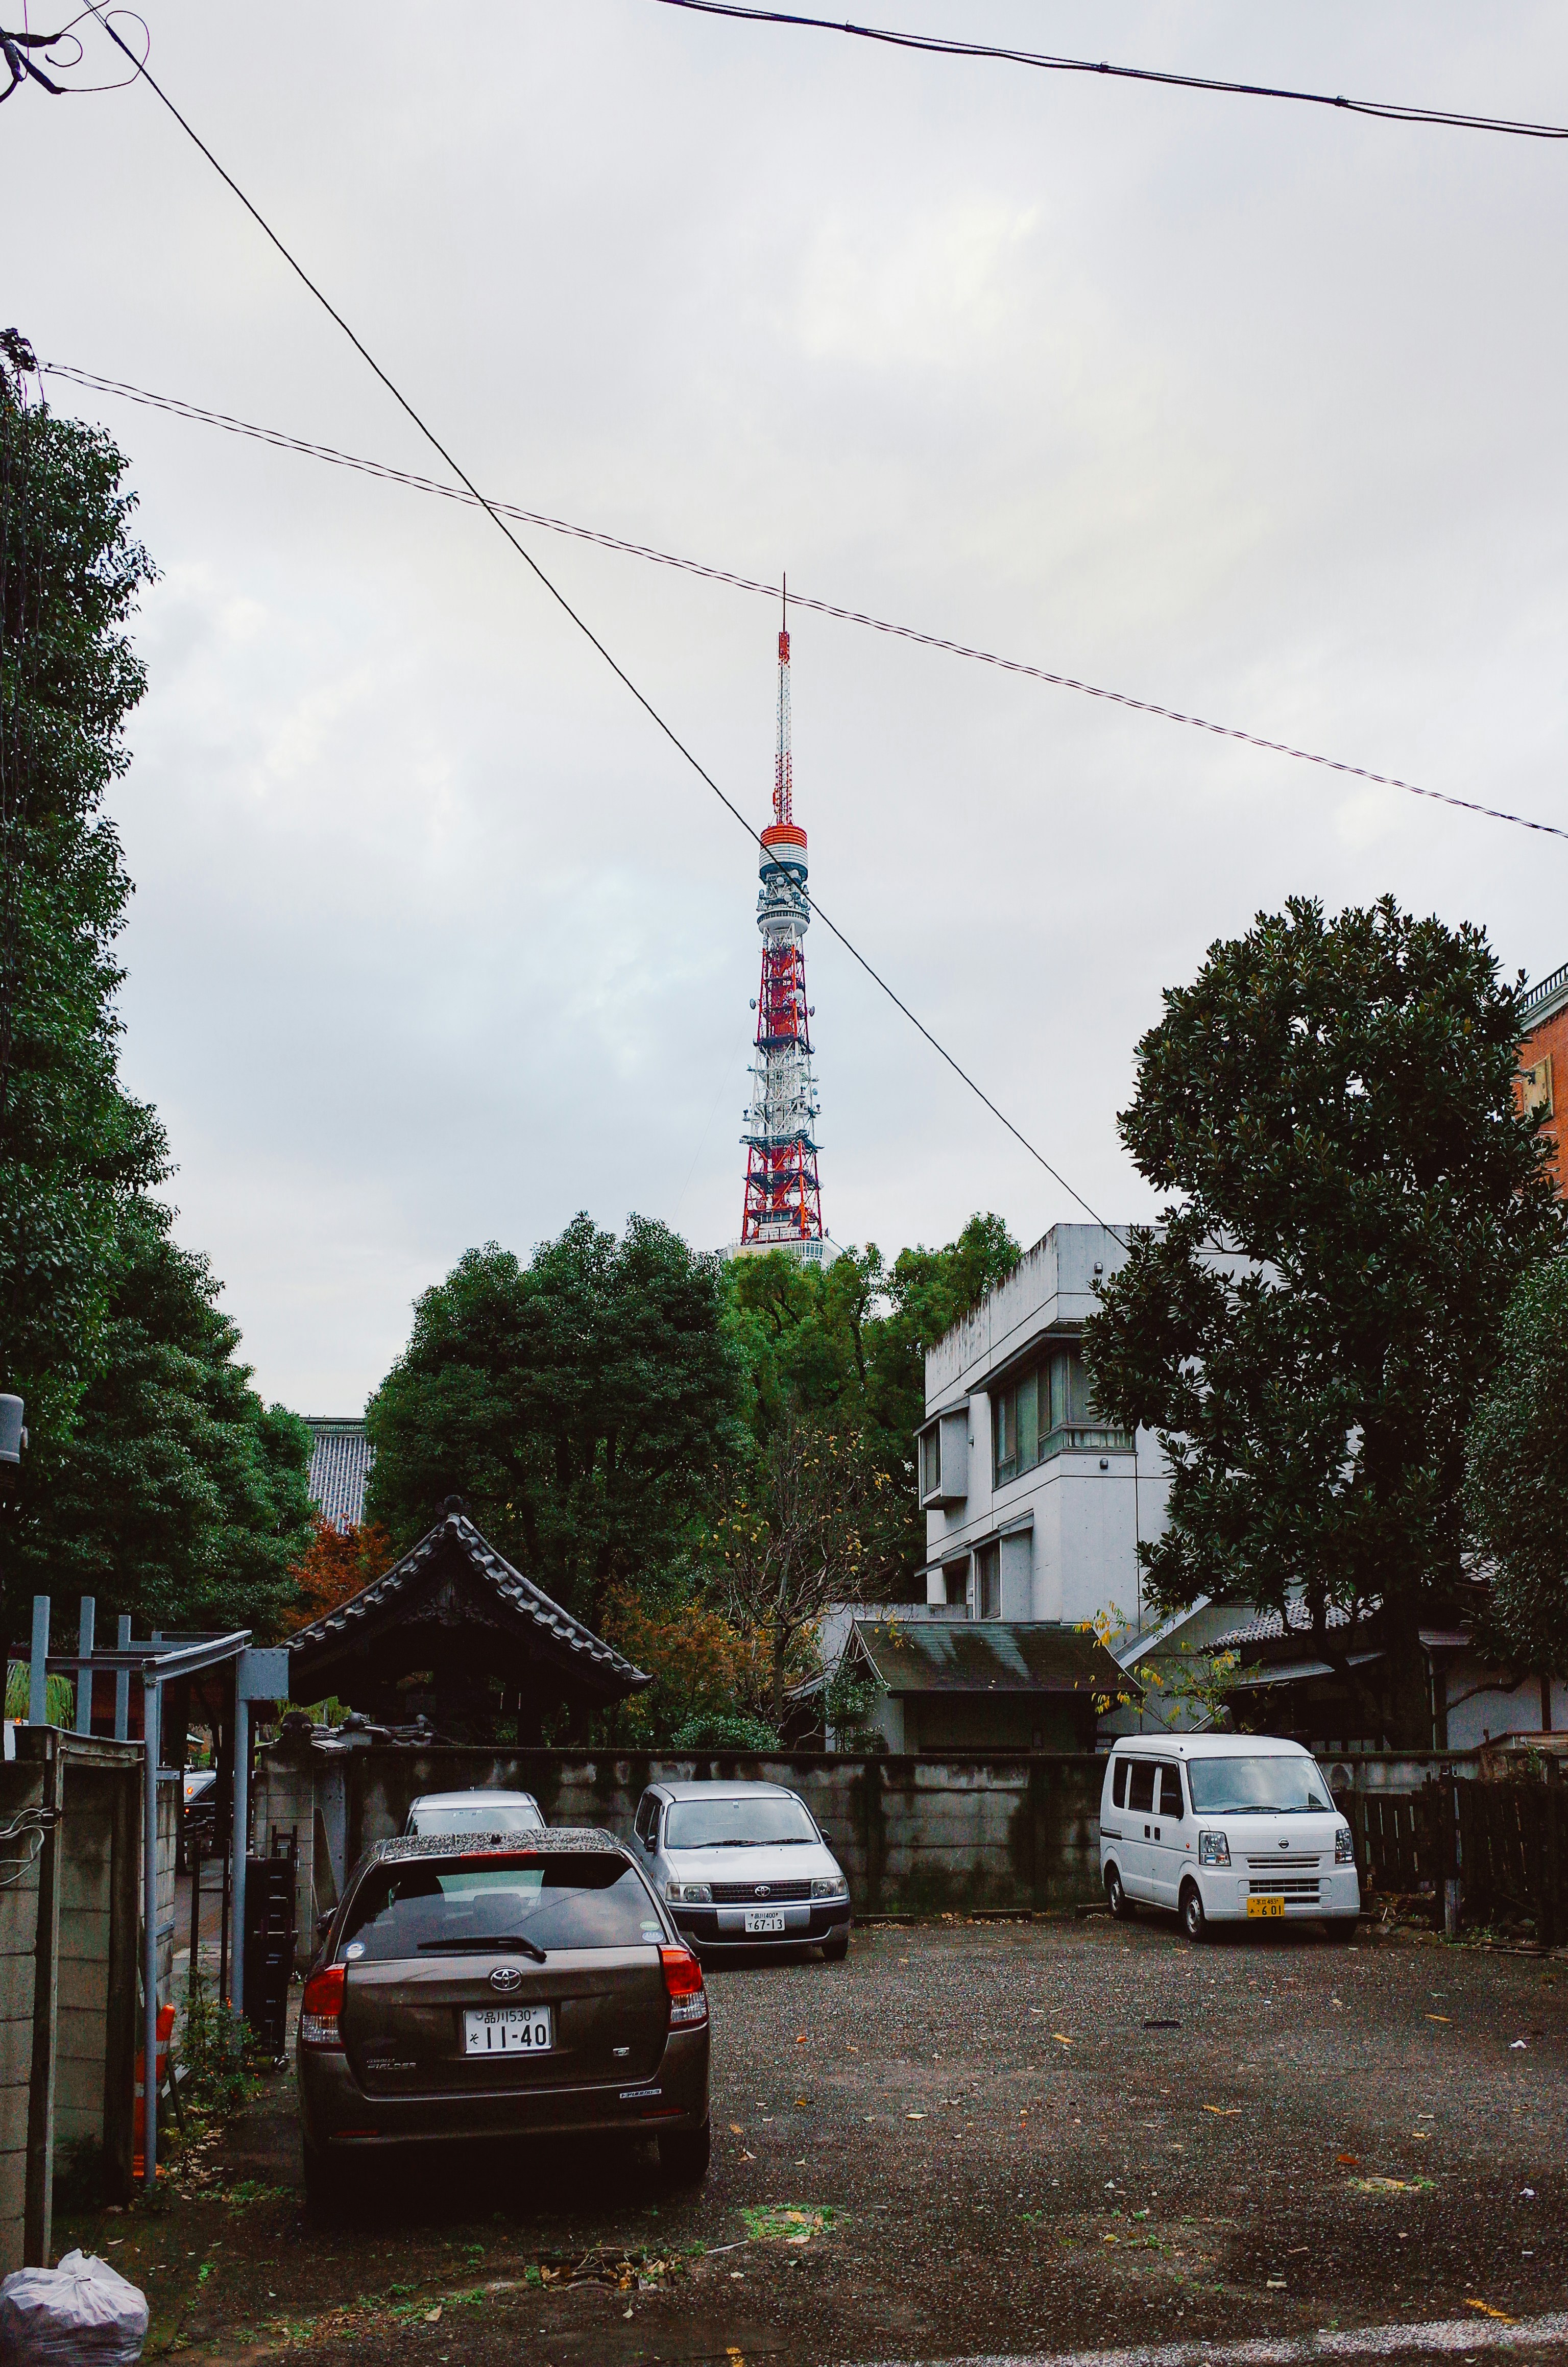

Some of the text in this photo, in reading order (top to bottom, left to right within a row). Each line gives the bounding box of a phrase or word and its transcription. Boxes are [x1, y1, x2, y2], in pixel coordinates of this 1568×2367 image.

[754, 1919, 782, 1930] 67-13
[470, 2024, 546, 2049] そ 11-40
